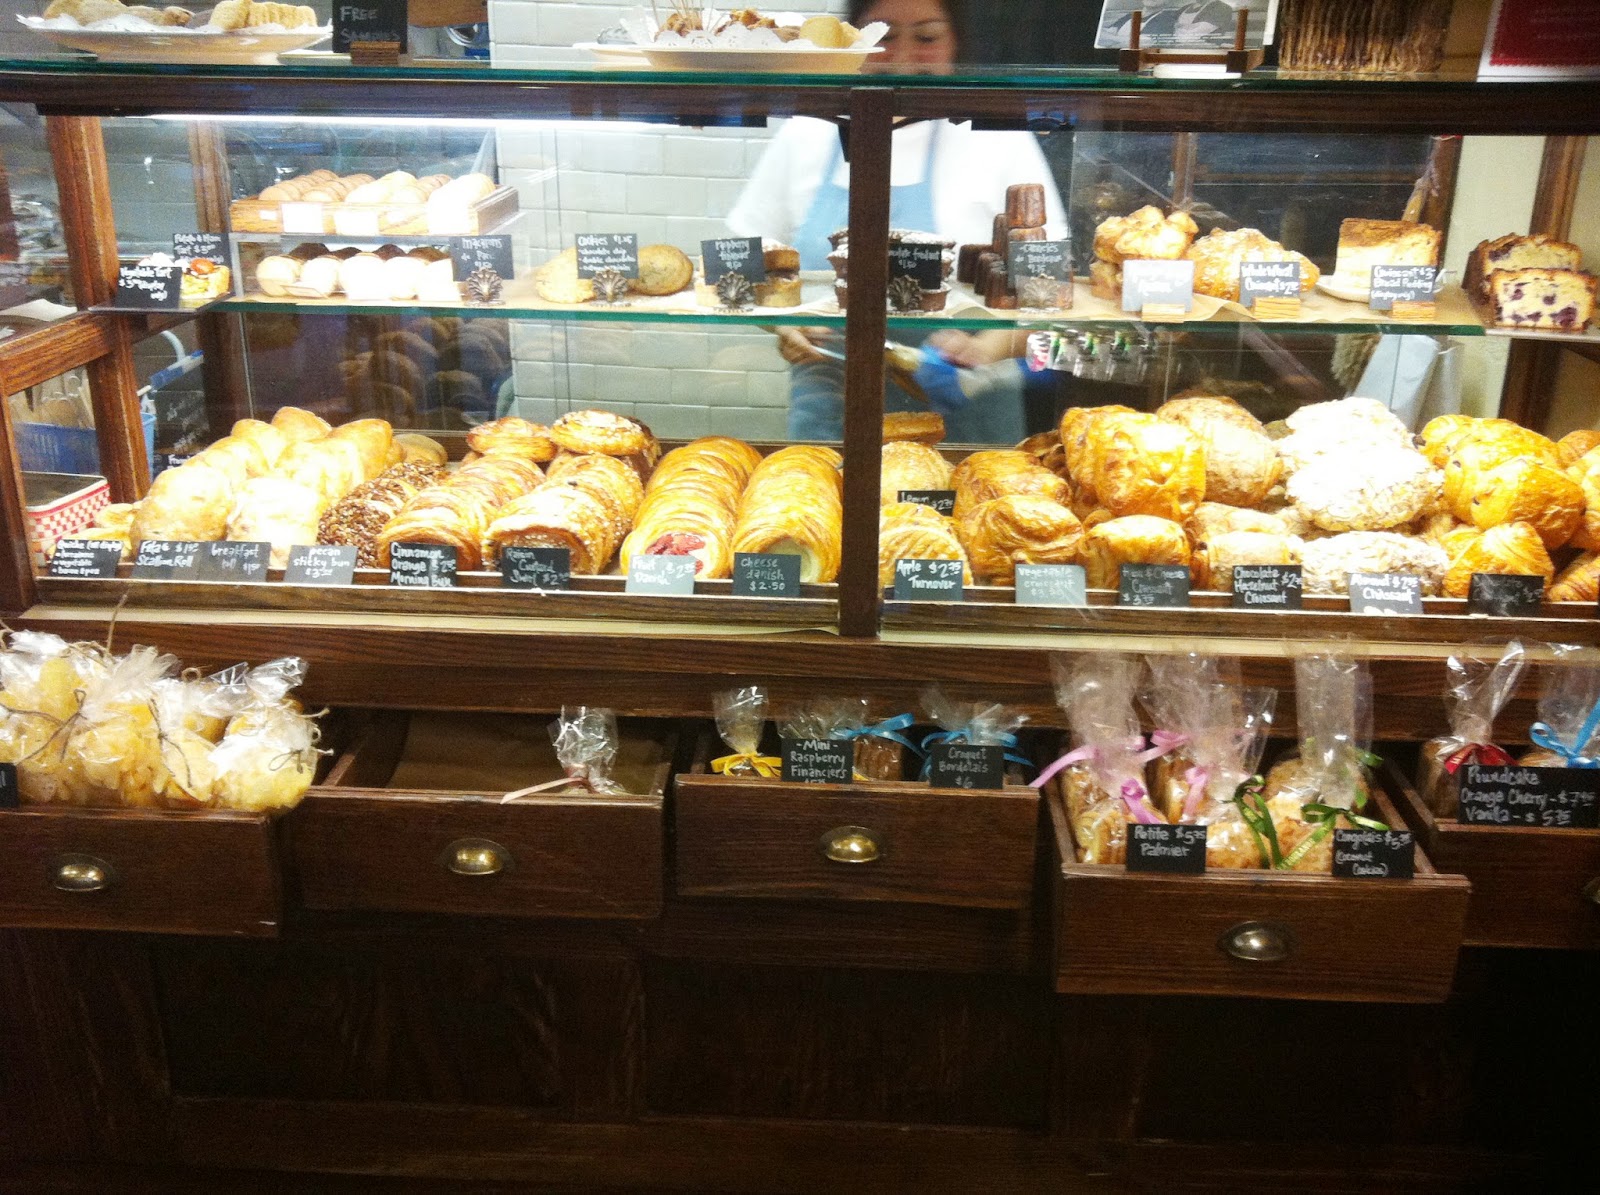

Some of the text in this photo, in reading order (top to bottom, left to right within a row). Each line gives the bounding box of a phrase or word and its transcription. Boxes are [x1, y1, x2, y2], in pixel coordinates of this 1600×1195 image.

[308, 548, 342, 561] pecan
[749, 580, 786, 592] $2.50
[790, 750, 846, 768] Raspberry
[791, 764, 849, 779] Financiers
[1460, 787, 1505, 808] Orange
